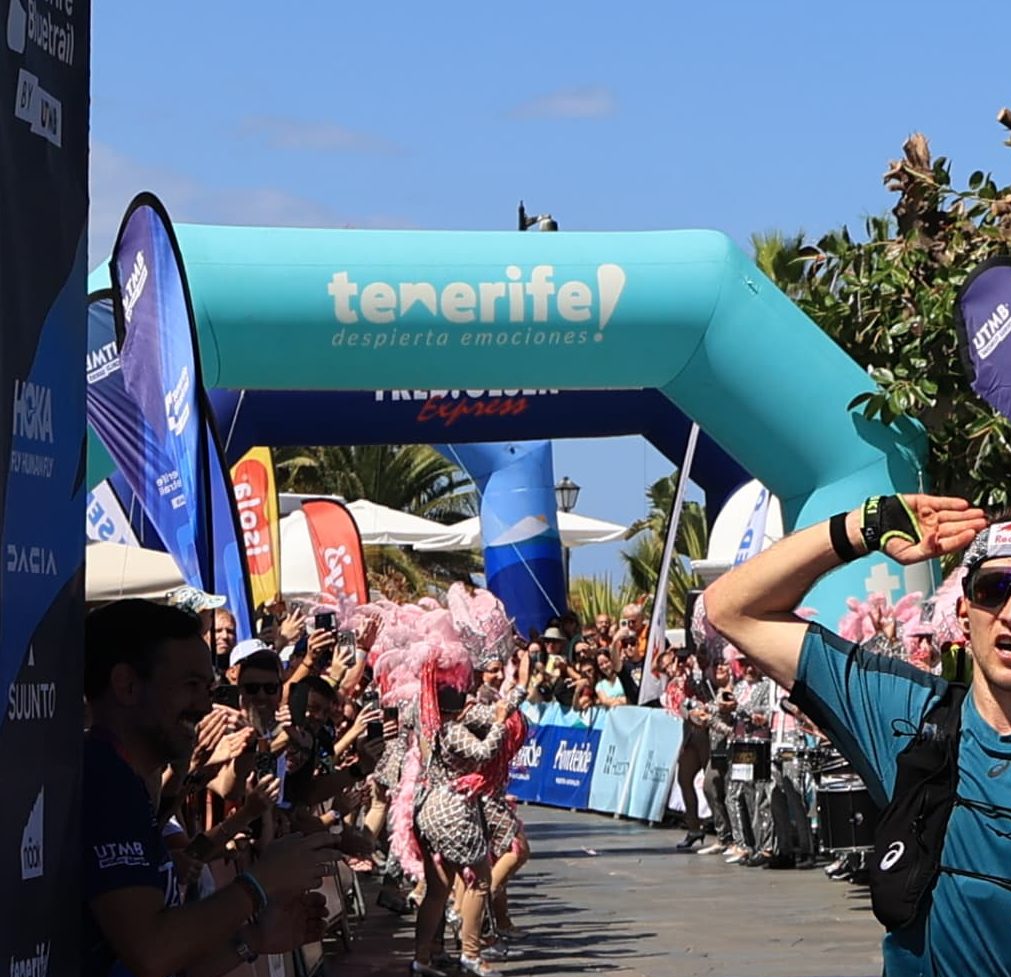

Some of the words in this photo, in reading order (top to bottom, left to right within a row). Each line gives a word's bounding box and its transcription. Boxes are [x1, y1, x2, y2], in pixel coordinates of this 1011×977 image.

[327, 263, 626, 342] tenerife!
[331, 329, 449, 349] despierta
[460, 329, 588, 347] emociones
[972, 303, 1009, 350] UTMB
[13, 379, 54, 443] HOKA
[416, 395, 530, 427] Express
[7, 544, 57, 576] DACIA
[8, 682, 56, 721] SUUNTO
[94, 841, 144, 859] UTMB
